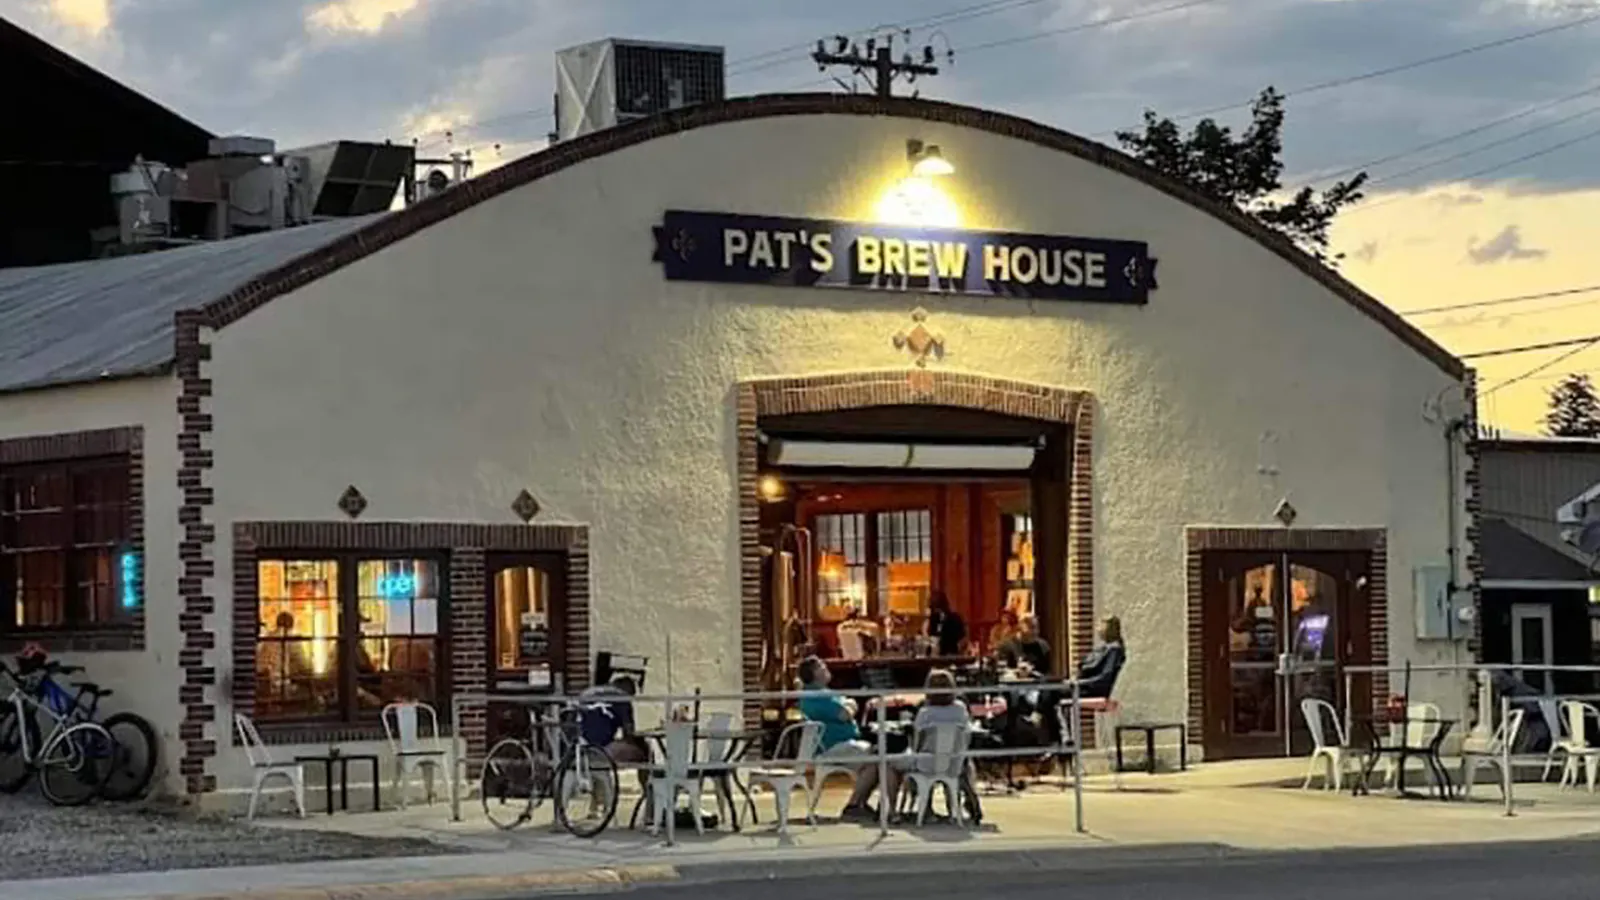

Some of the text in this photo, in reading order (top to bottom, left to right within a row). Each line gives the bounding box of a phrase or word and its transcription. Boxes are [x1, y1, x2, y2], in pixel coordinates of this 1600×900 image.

[723, 228, 1106, 288] PAT'S BREW HOUSE
